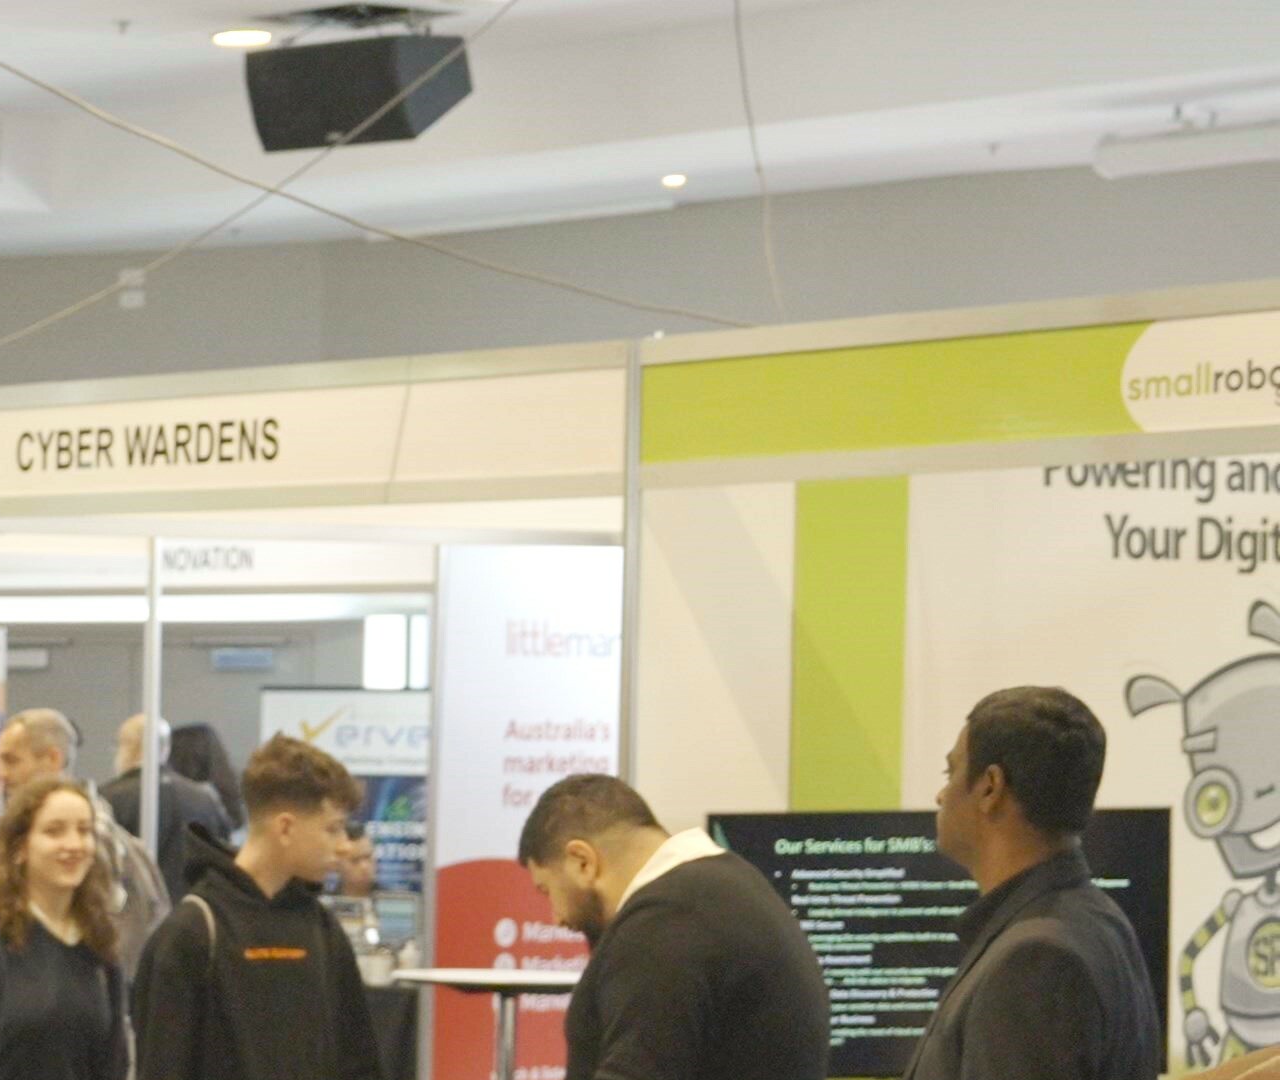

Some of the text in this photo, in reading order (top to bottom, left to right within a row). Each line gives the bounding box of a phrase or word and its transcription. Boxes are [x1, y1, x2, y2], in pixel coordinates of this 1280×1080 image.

[16, 417, 280, 472] CYBER WARDENS
[1105, 513, 1188, 561] Your
[504, 718, 610, 742] Australia's
[500, 784, 534, 807] for
[774, 838, 803, 855] Our
[804, 838, 863, 855] Services
[864, 836, 886, 854] for
